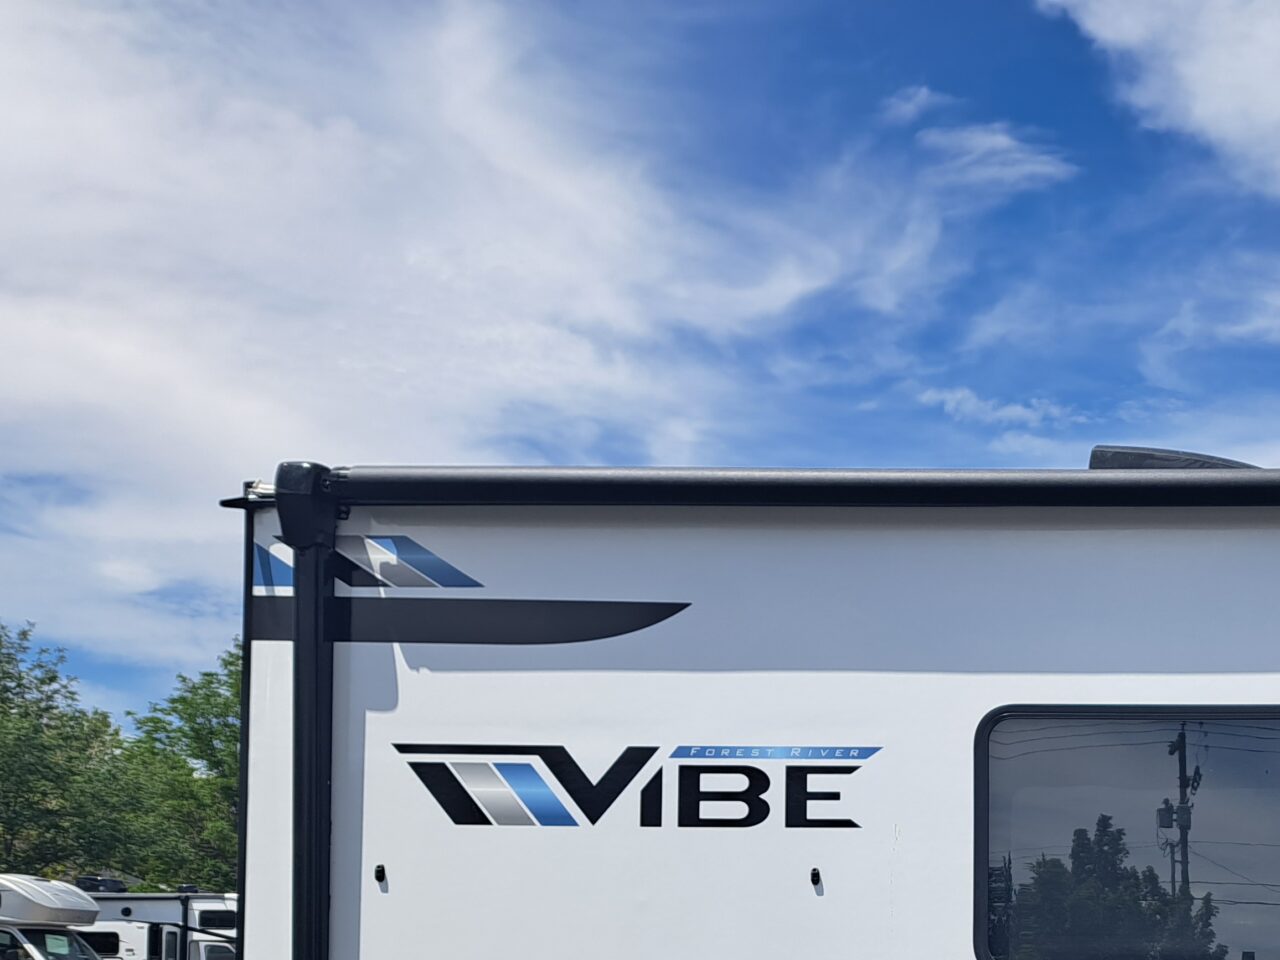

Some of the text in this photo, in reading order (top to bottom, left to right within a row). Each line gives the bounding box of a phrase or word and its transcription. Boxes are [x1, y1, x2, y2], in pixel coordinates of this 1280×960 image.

[690, 747, 861, 758] FOREST RIVER
[391, 743, 863, 828] VIBE
